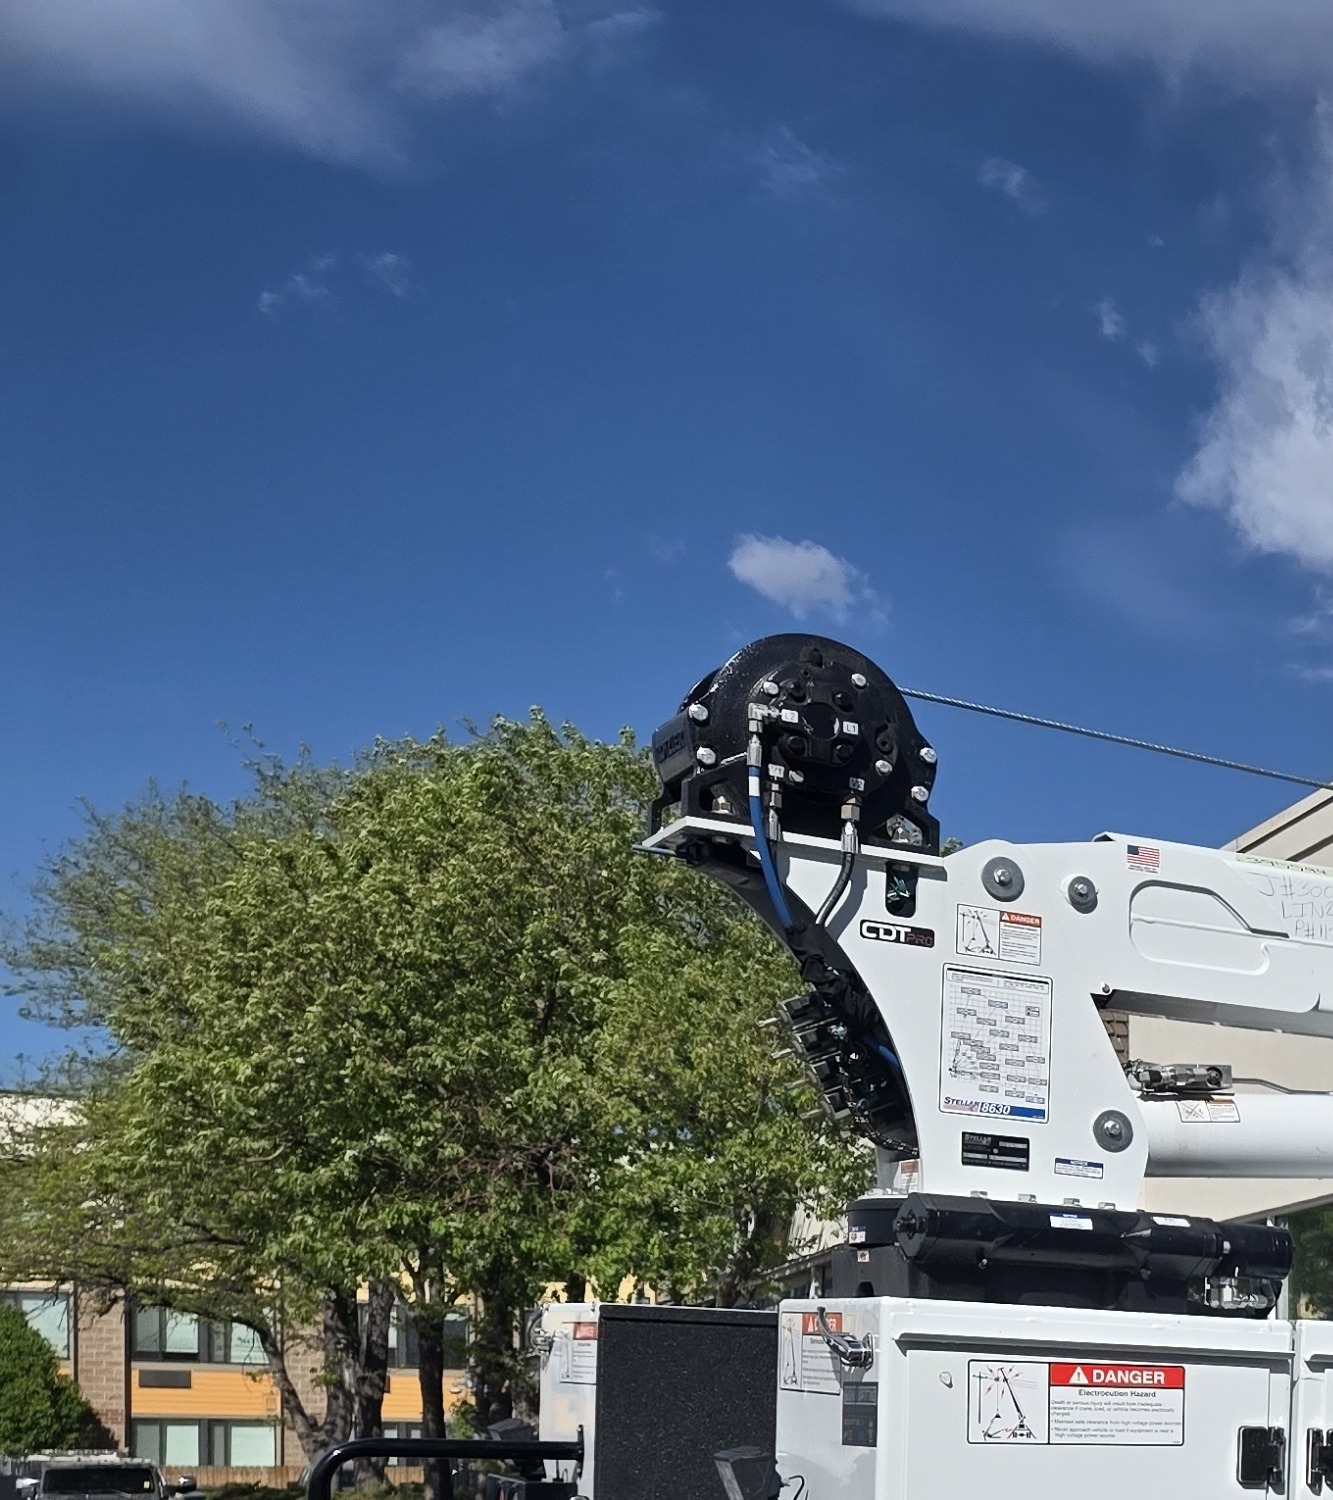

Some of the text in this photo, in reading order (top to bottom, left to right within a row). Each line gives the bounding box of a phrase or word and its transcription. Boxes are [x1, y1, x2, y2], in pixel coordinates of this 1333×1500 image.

[944, 1096, 1011, 1115] STELLAR 8630
[1092, 1370, 1165, 1384] DANGER
[1078, 1389, 1156, 1398] Electrocution Hazard
